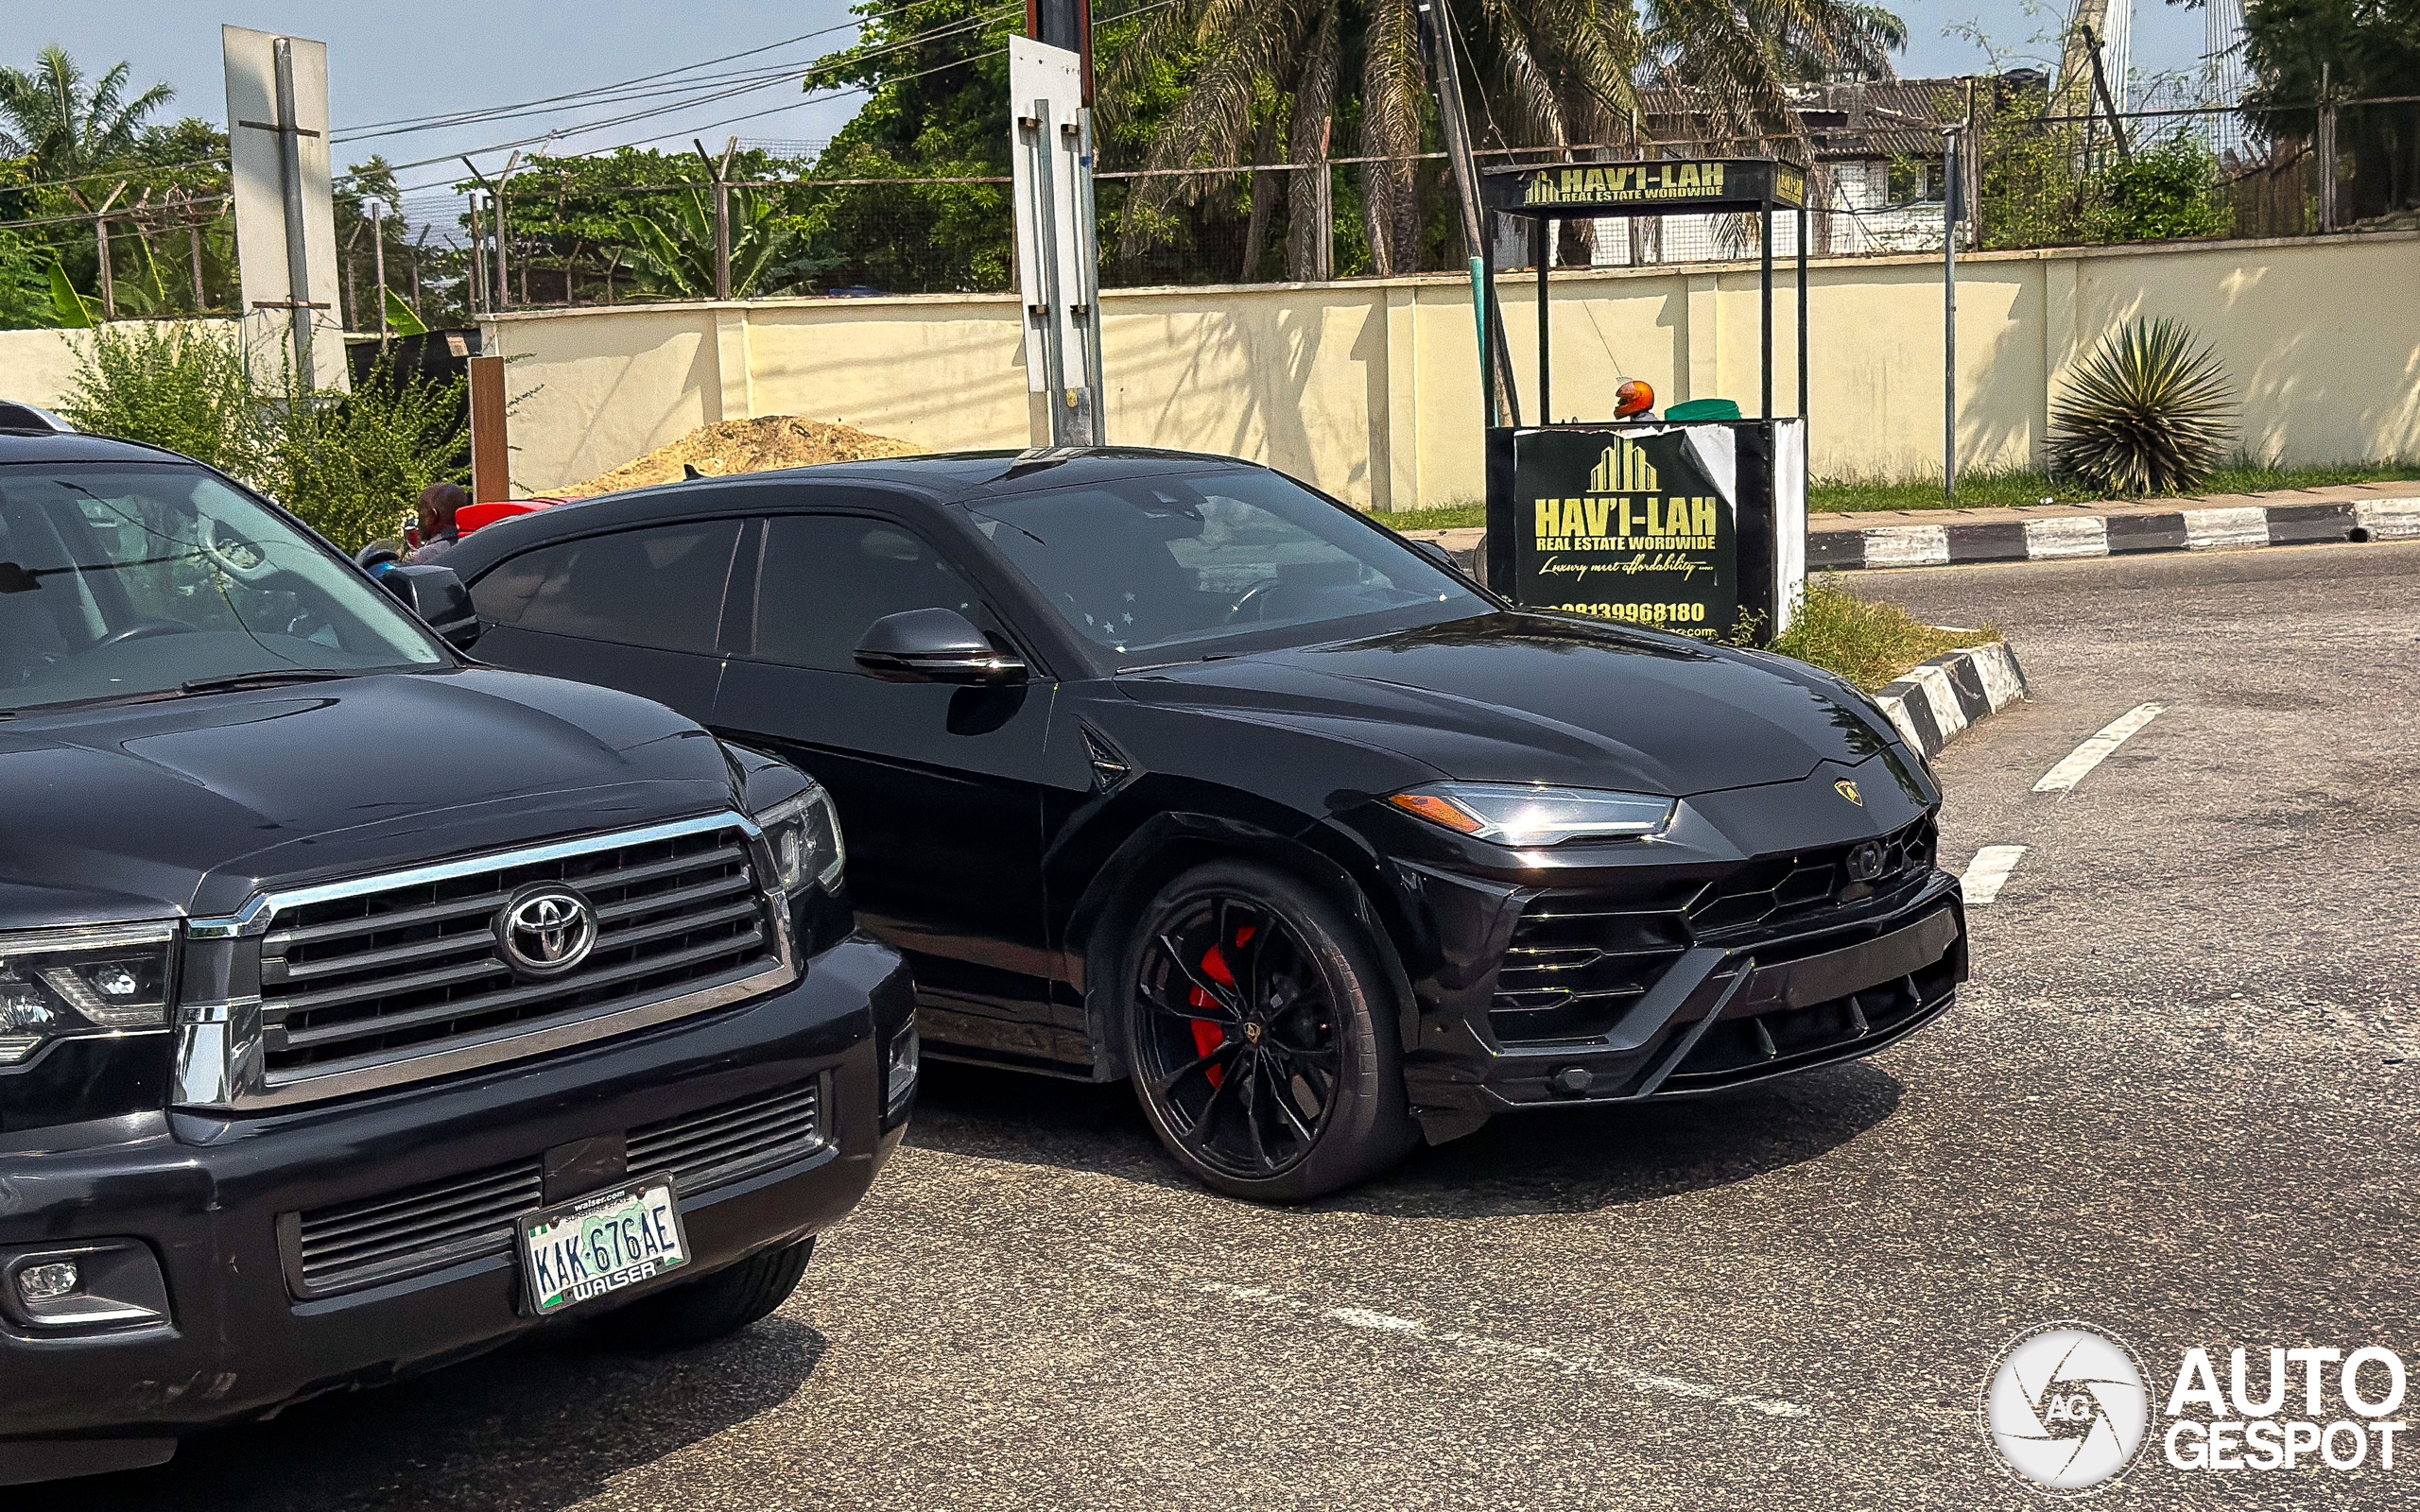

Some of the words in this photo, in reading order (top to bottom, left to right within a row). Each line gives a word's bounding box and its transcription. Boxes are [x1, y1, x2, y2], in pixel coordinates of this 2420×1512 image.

[1561, 163, 1724, 193] HAV'I-LAH
[1562, 190, 1594, 203] REAL
[1596, 188, 1643, 202] ESTATE
[1645, 185, 1723, 199] WORDWIDE
[1535, 496, 1717, 537] HAV'I-LAH
[1536, 537, 1571, 551] REAL
[1574, 537, 1625, 551] ESTATE
[1628, 536, 1716, 550] WORDWIDE
[1538, 556, 1588, 582] Luxury
[1590, 562, 1622, 572] meet
[1622, 553, 1706, 581] affordability
[574, 1190, 625, 1211] walser.com
[573, 1261, 657, 1301] WALSER
